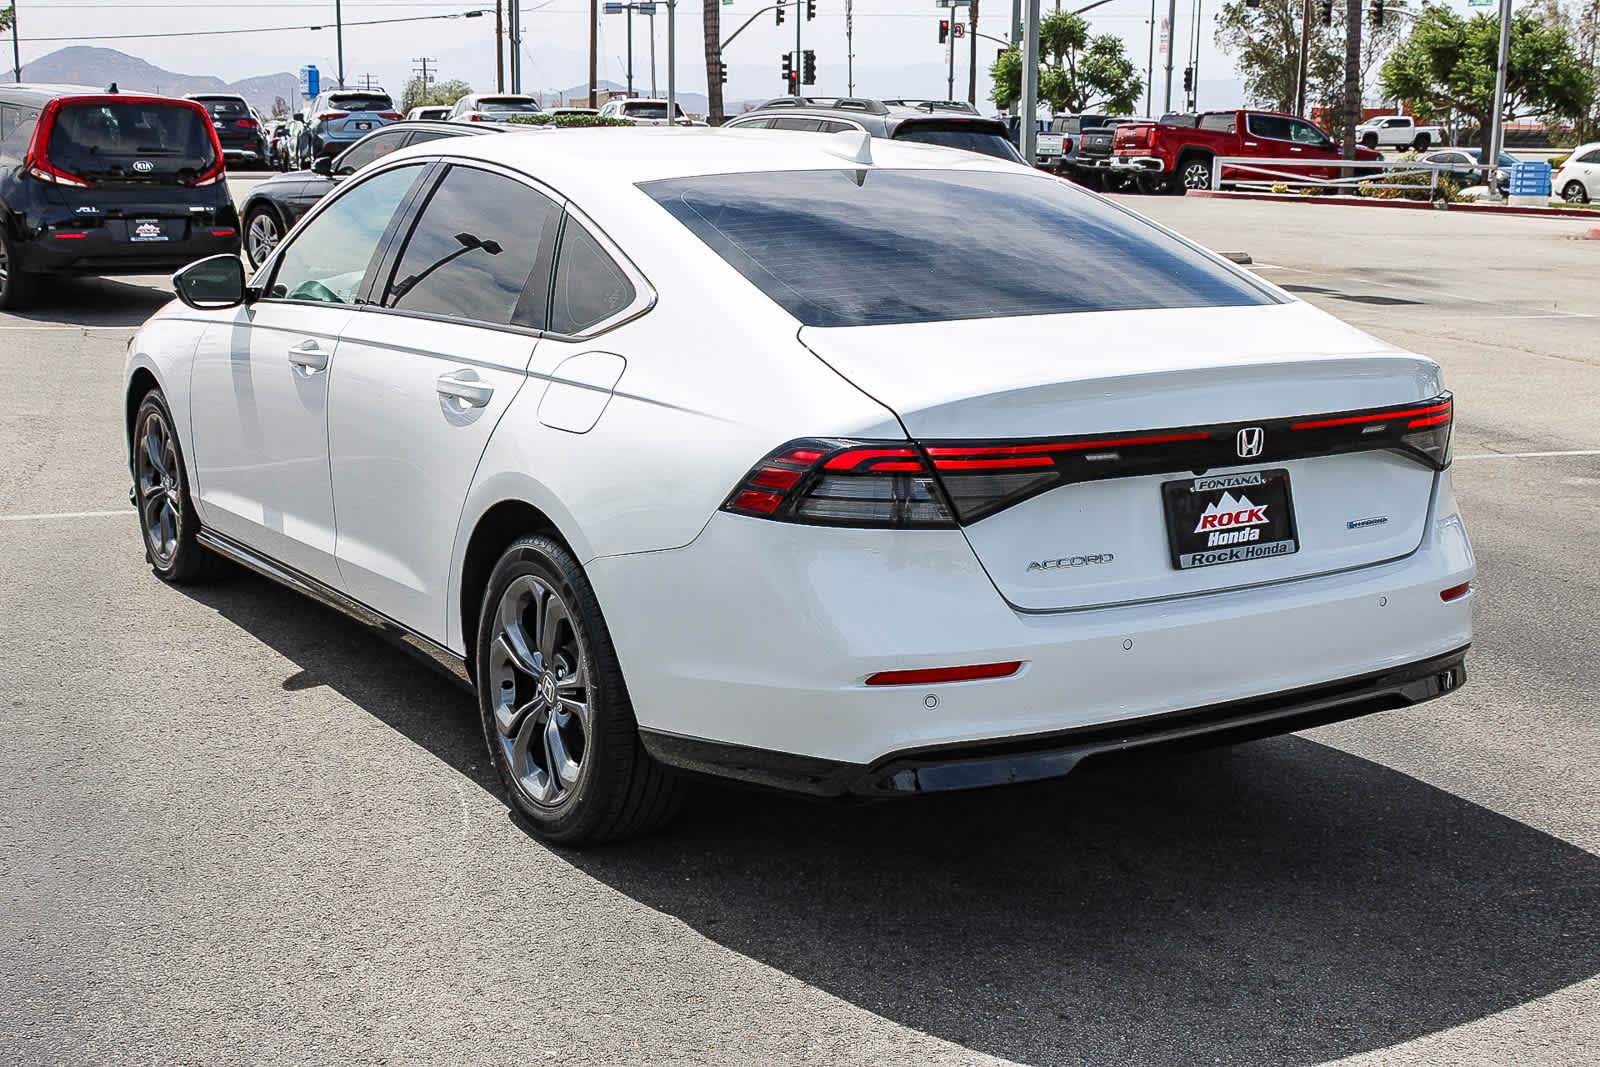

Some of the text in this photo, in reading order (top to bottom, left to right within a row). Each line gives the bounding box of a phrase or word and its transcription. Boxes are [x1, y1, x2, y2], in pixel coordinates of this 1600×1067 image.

[135, 162, 152, 171] KIA
[1199, 476, 1260, 490] FONTANA
[1201, 507, 1265, 529] ROCK
[1207, 527, 1261, 547] Honda
[1026, 553, 1114, 572] ACCORD
[1190, 542, 1288, 566] Rock Honda
